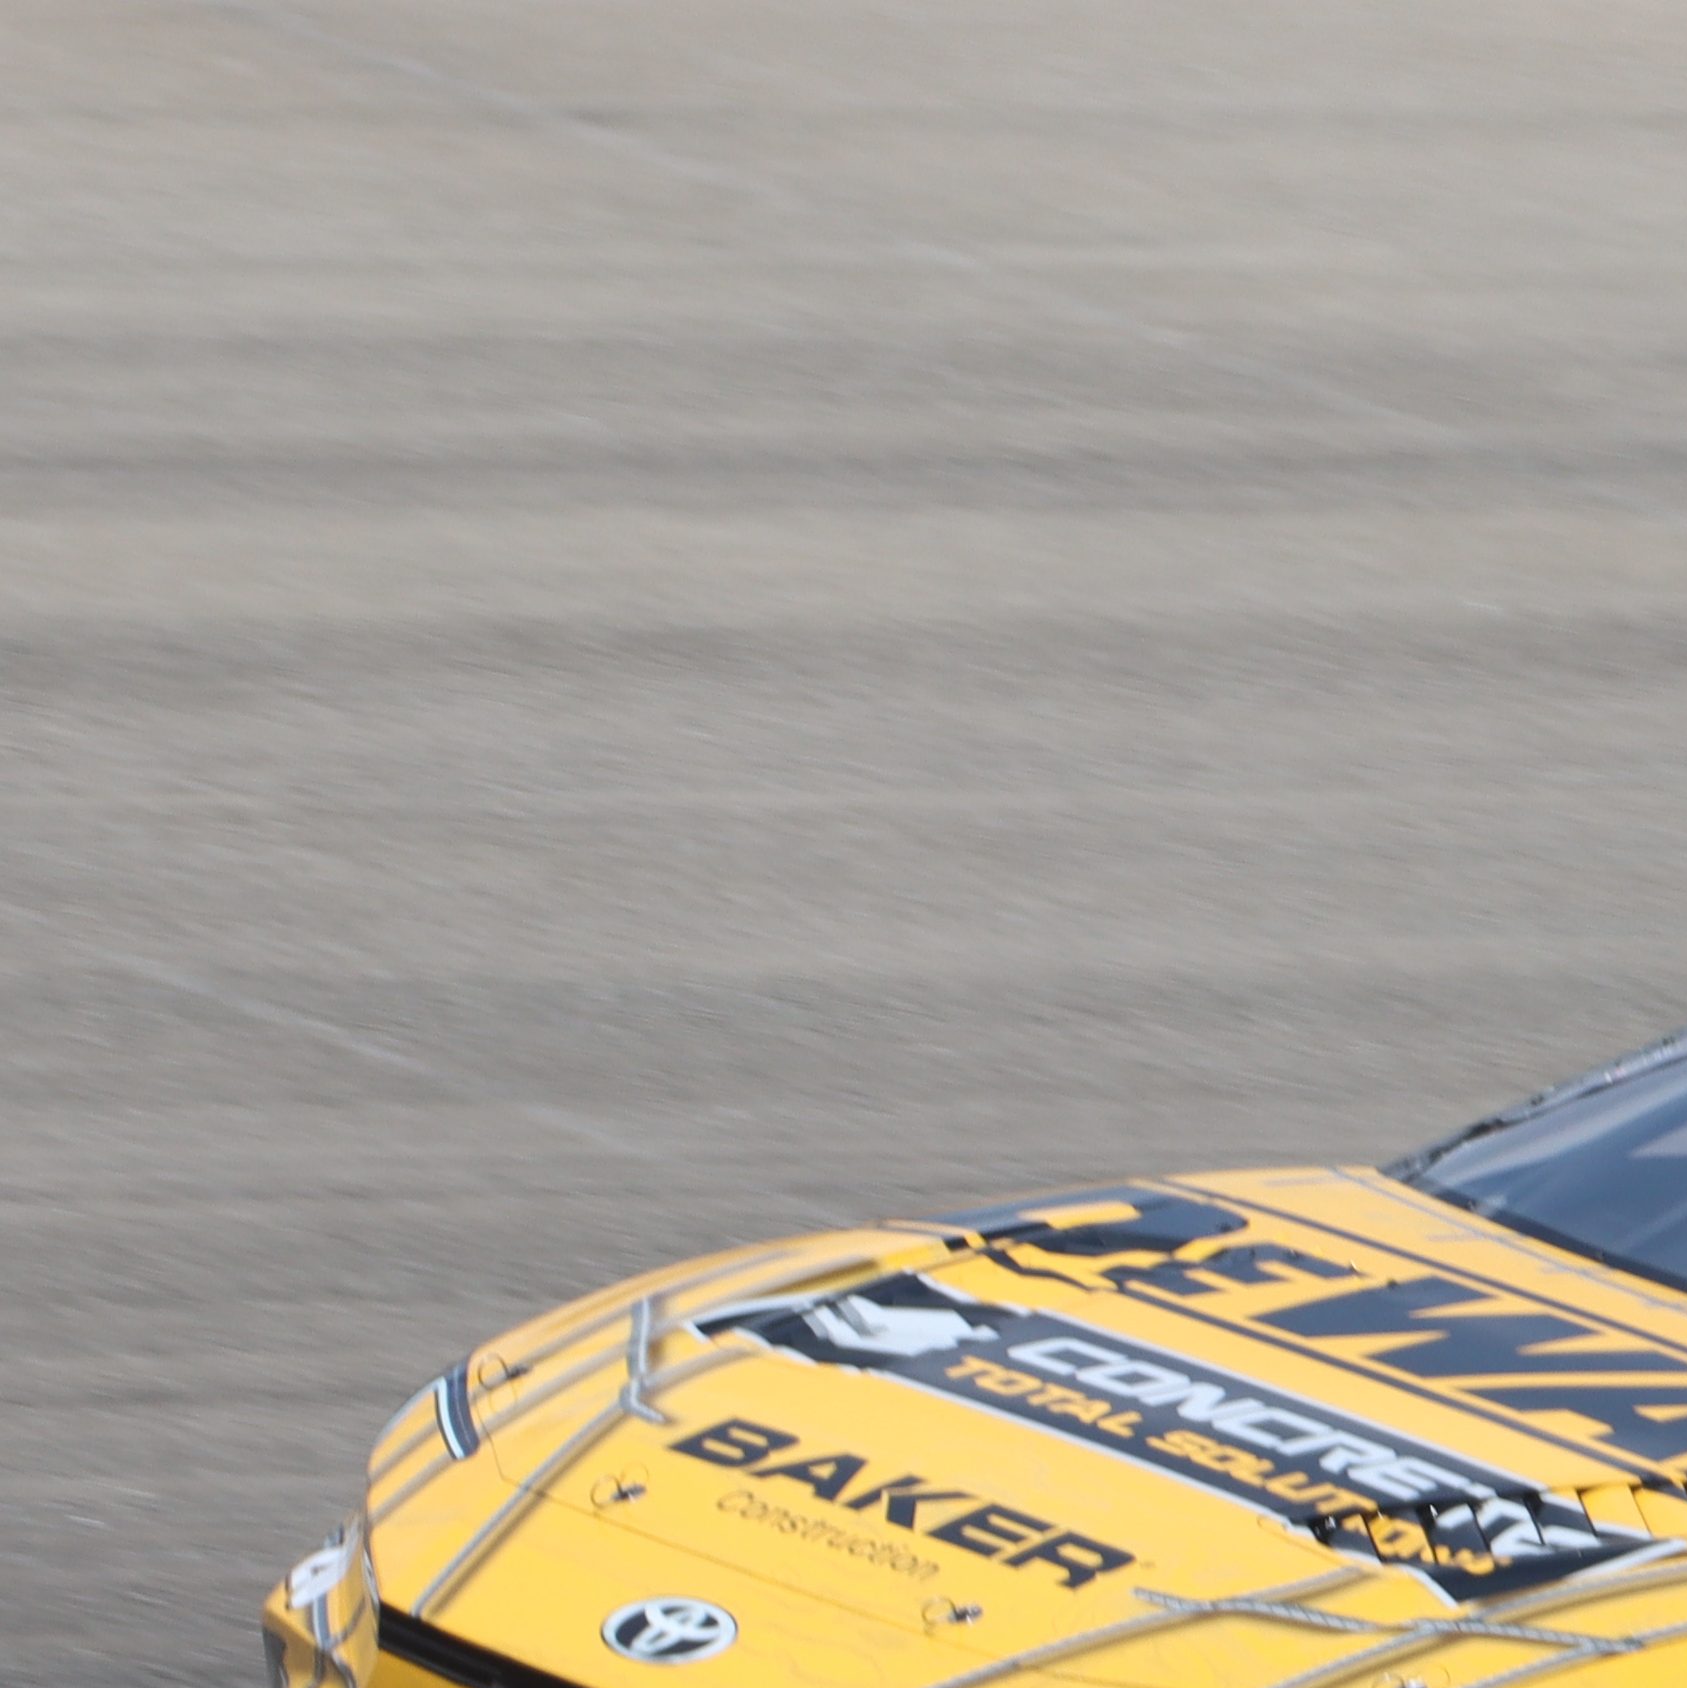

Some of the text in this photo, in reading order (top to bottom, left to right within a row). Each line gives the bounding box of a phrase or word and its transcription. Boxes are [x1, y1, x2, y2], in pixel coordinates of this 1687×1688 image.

[945, 1354, 1144, 1440] TOTAL
[665, 1418, 1137, 1591] BAKER
[716, 1489, 942, 1582] Construction
